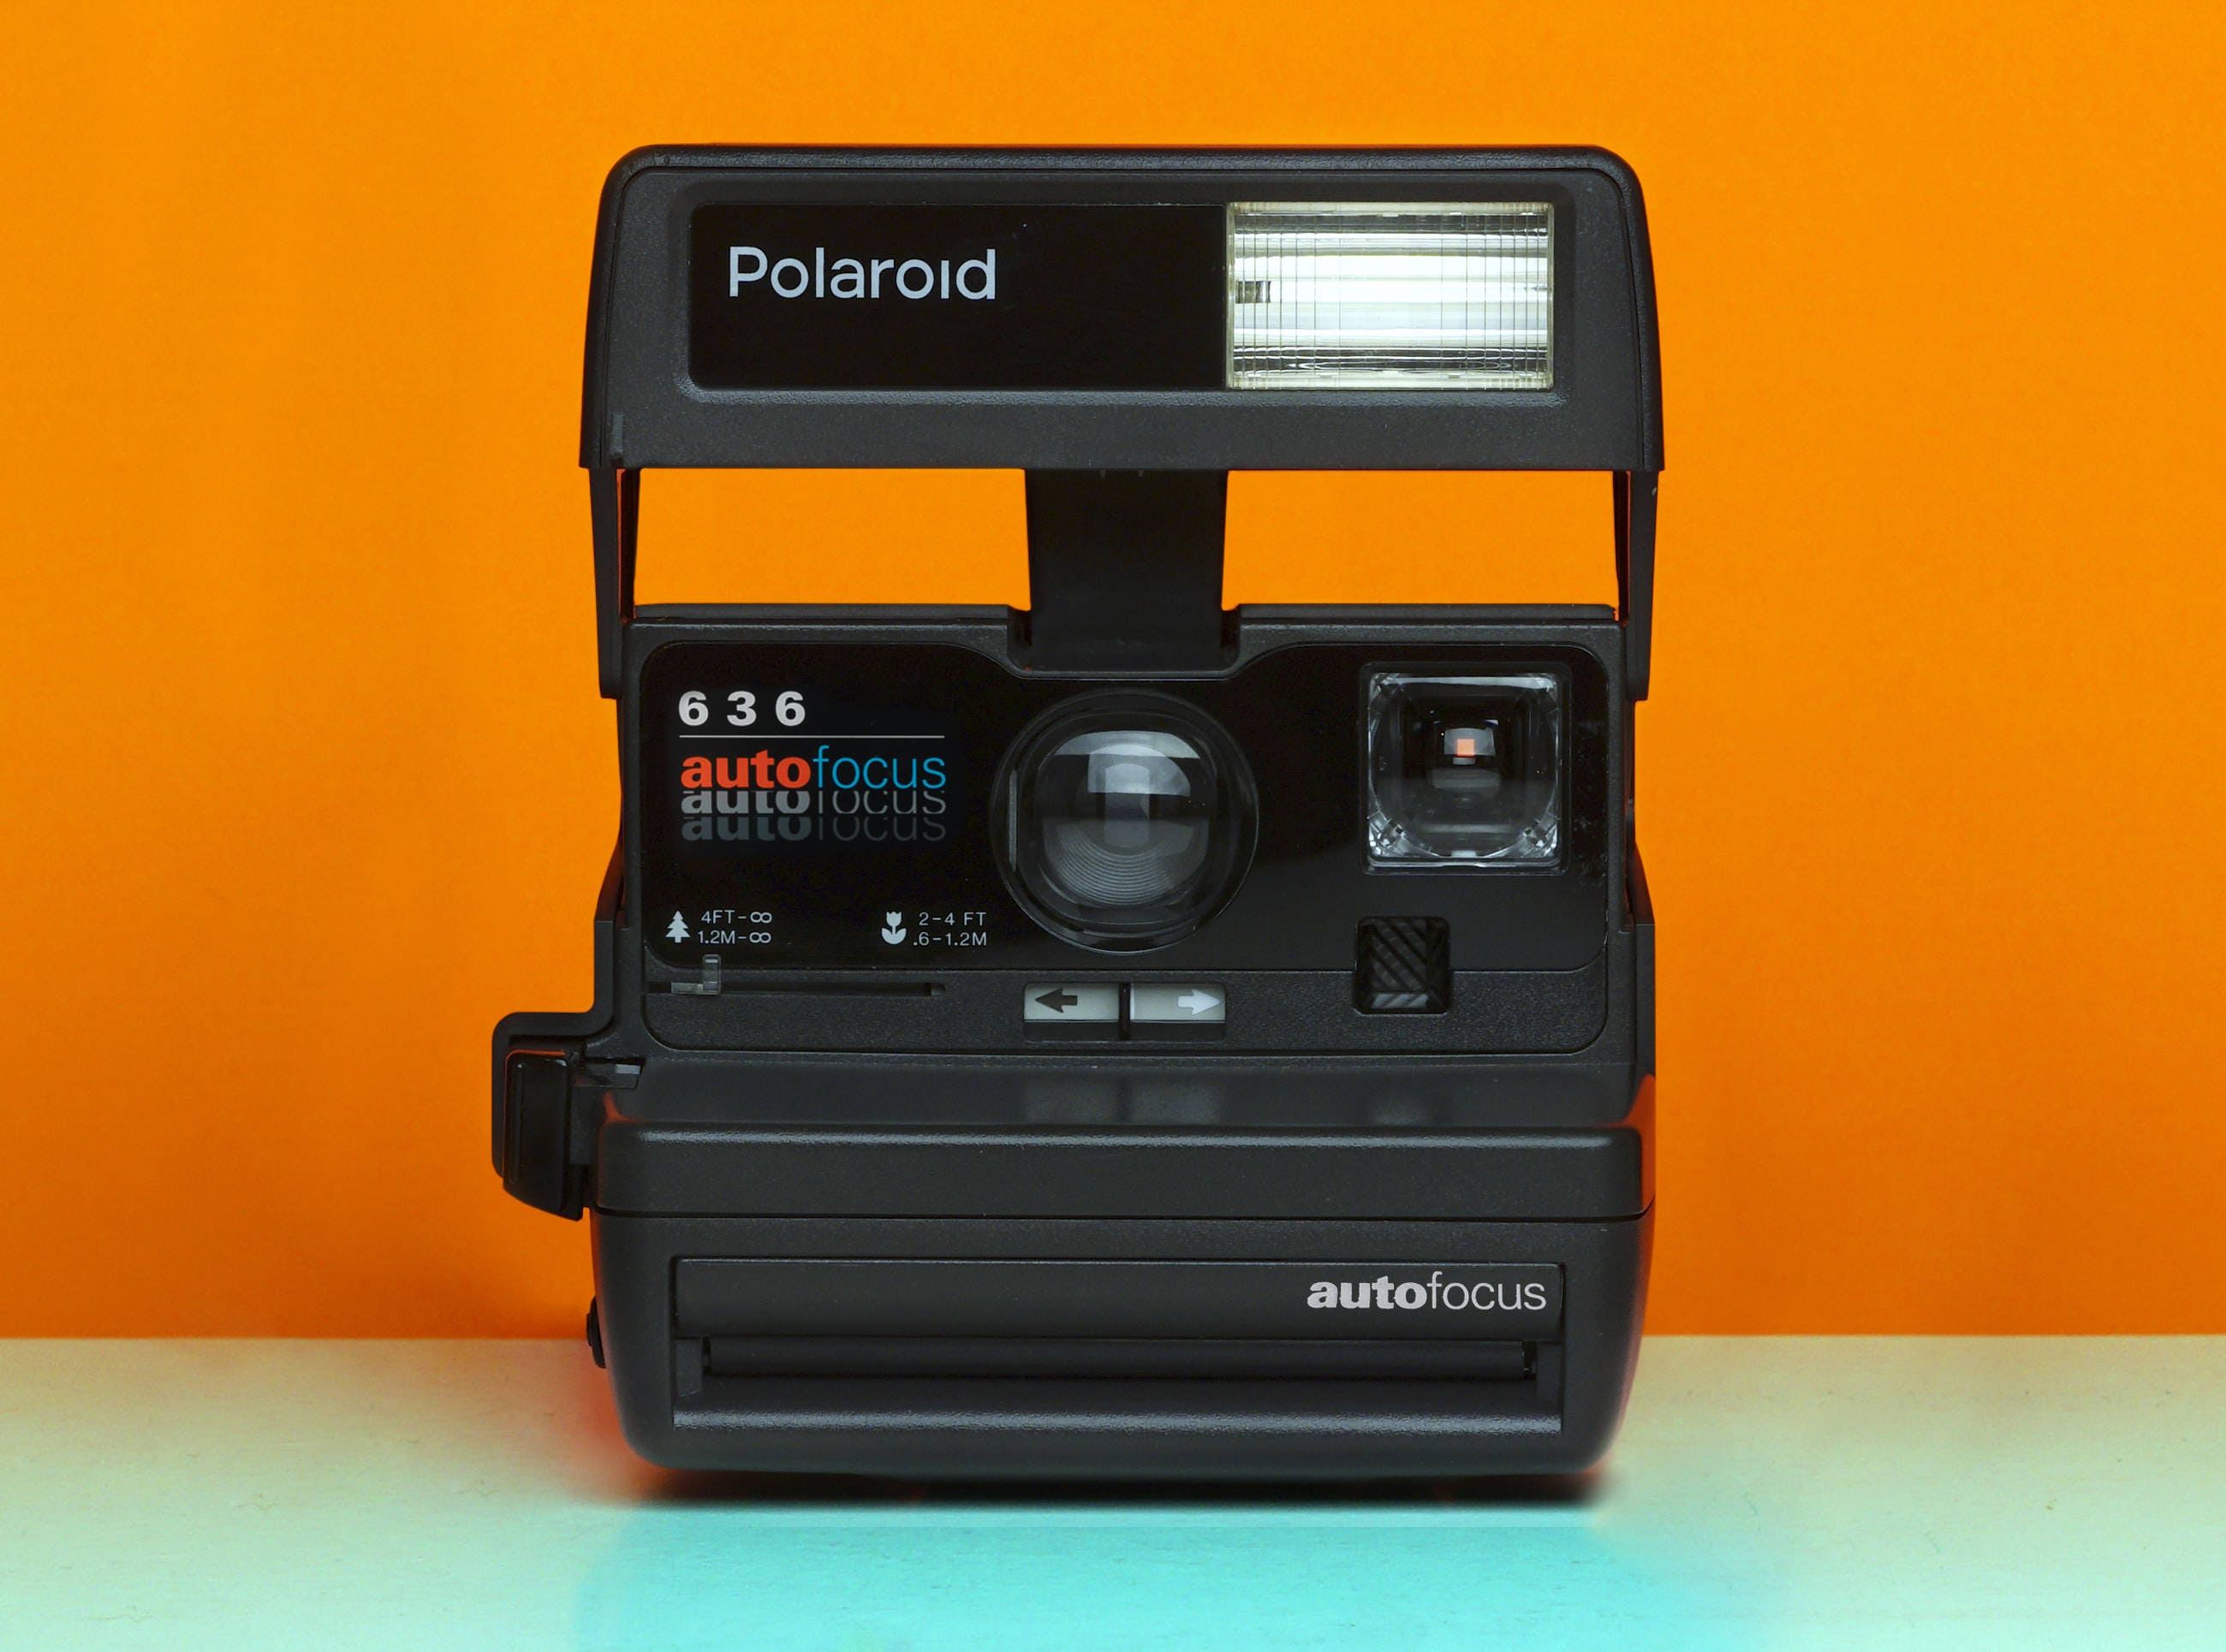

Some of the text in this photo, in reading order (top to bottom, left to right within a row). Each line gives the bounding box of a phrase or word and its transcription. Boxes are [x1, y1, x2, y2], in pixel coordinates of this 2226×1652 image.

[729, 246, 996, 300] Polaroid
[680, 745, 946, 789] autofocus
[913, 931, 987, 946] .6-1.2M
[964, 912, 986, 926] FT
[1306, 1271, 1547, 1310] autofocus
